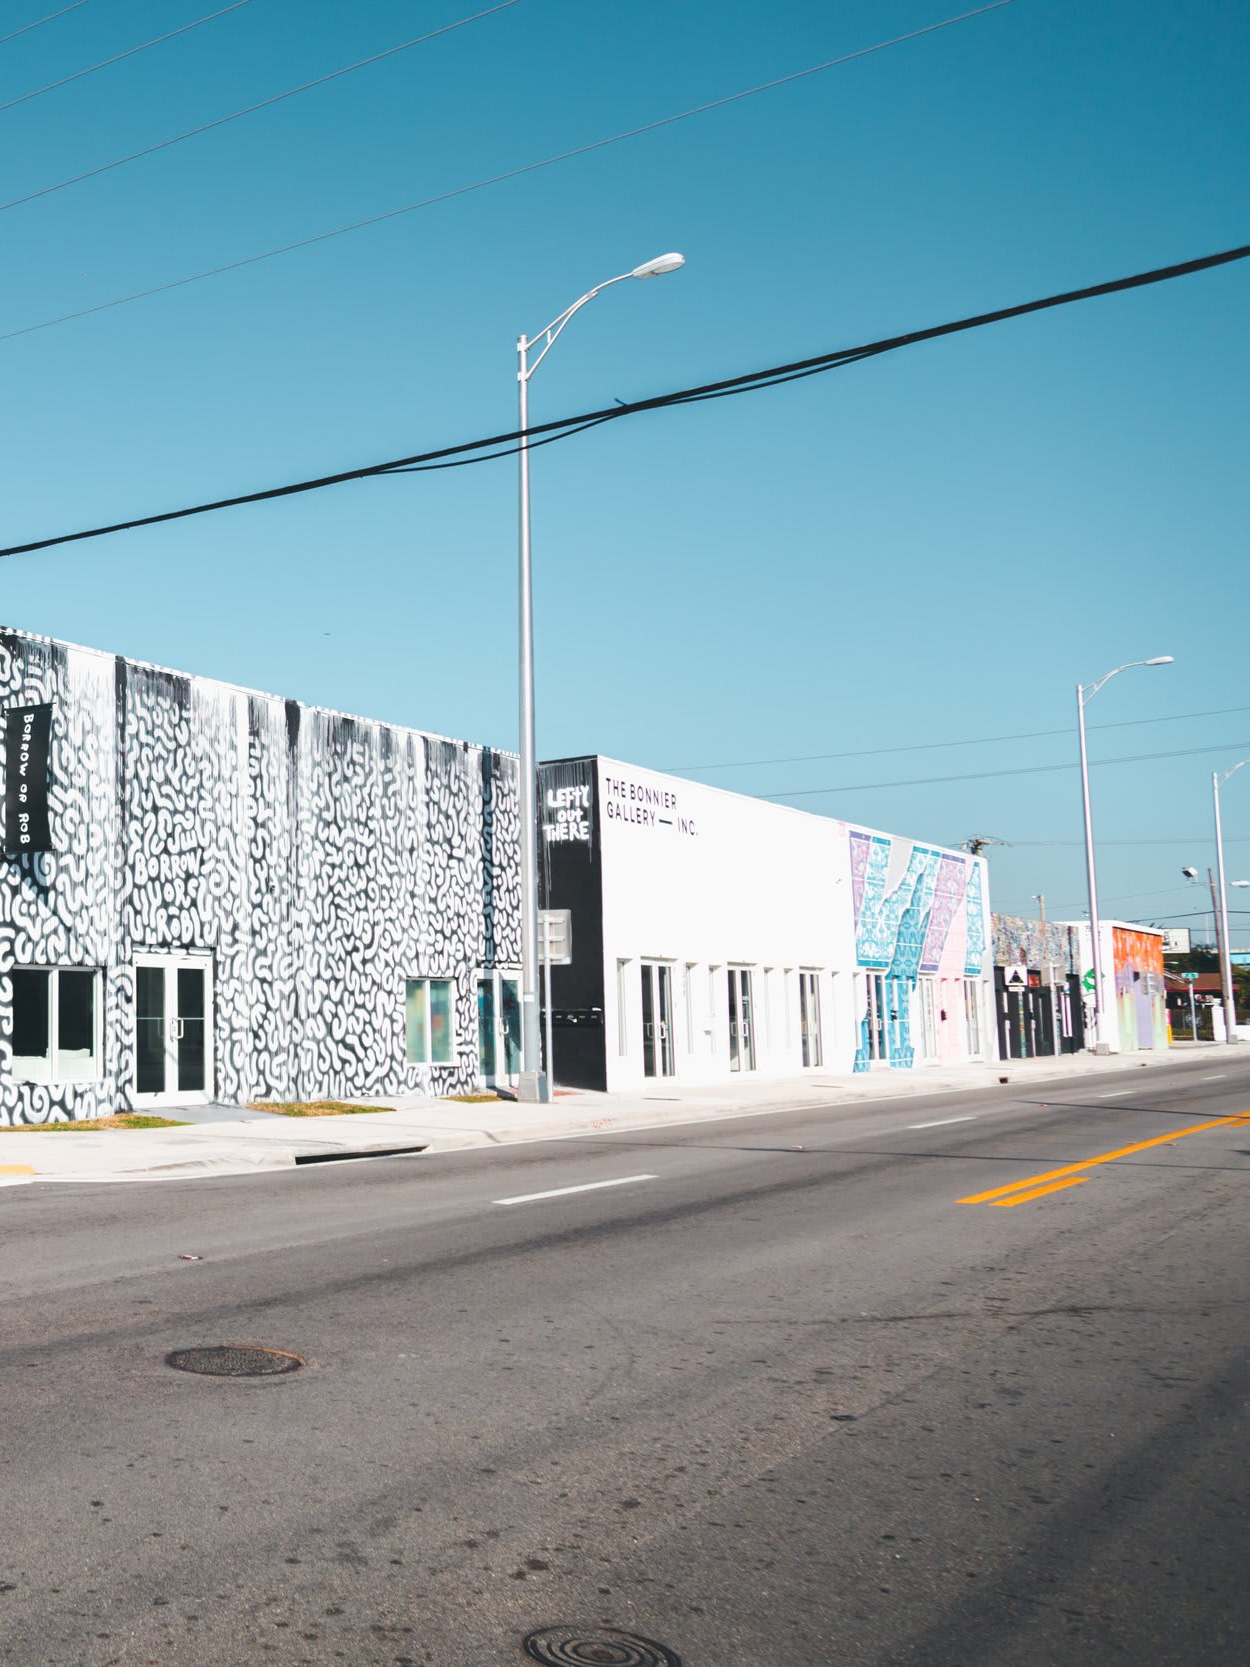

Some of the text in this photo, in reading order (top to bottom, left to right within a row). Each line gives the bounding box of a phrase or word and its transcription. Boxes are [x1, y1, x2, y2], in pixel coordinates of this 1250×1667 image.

[18, 713, 35, 844] BORROW OR ROB
[606, 777, 677, 810] THE BONNIER
[542, 821, 590, 842] THERE
[607, 801, 656, 827] GALLERY
[677, 817, 698, 836] INC.
[134, 847, 203, 886] BORROW
